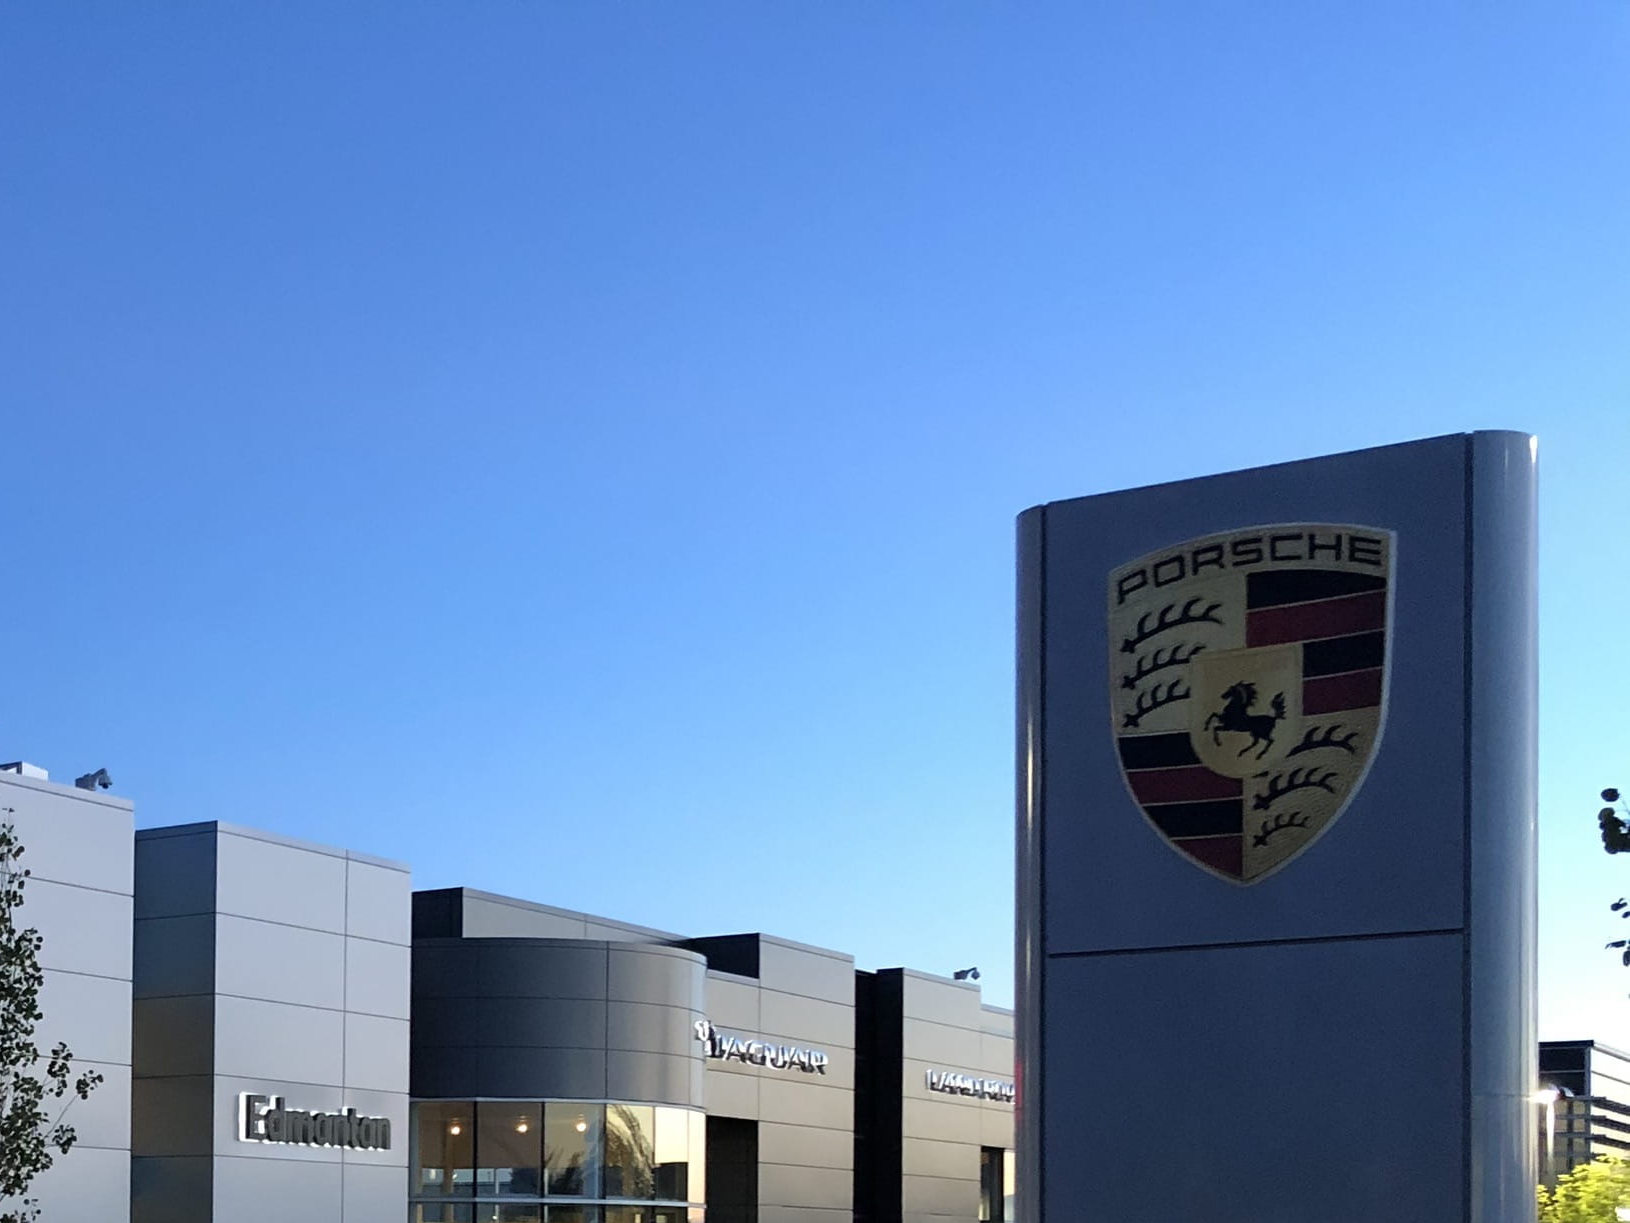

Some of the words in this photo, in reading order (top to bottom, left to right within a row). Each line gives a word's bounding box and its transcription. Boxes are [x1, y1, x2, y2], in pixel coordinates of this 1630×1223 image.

[1117, 533, 1382, 605] PORSCHE
[705, 1035, 829, 1075] JAGUAR
[239, 1092, 391, 1150] Edmonton
